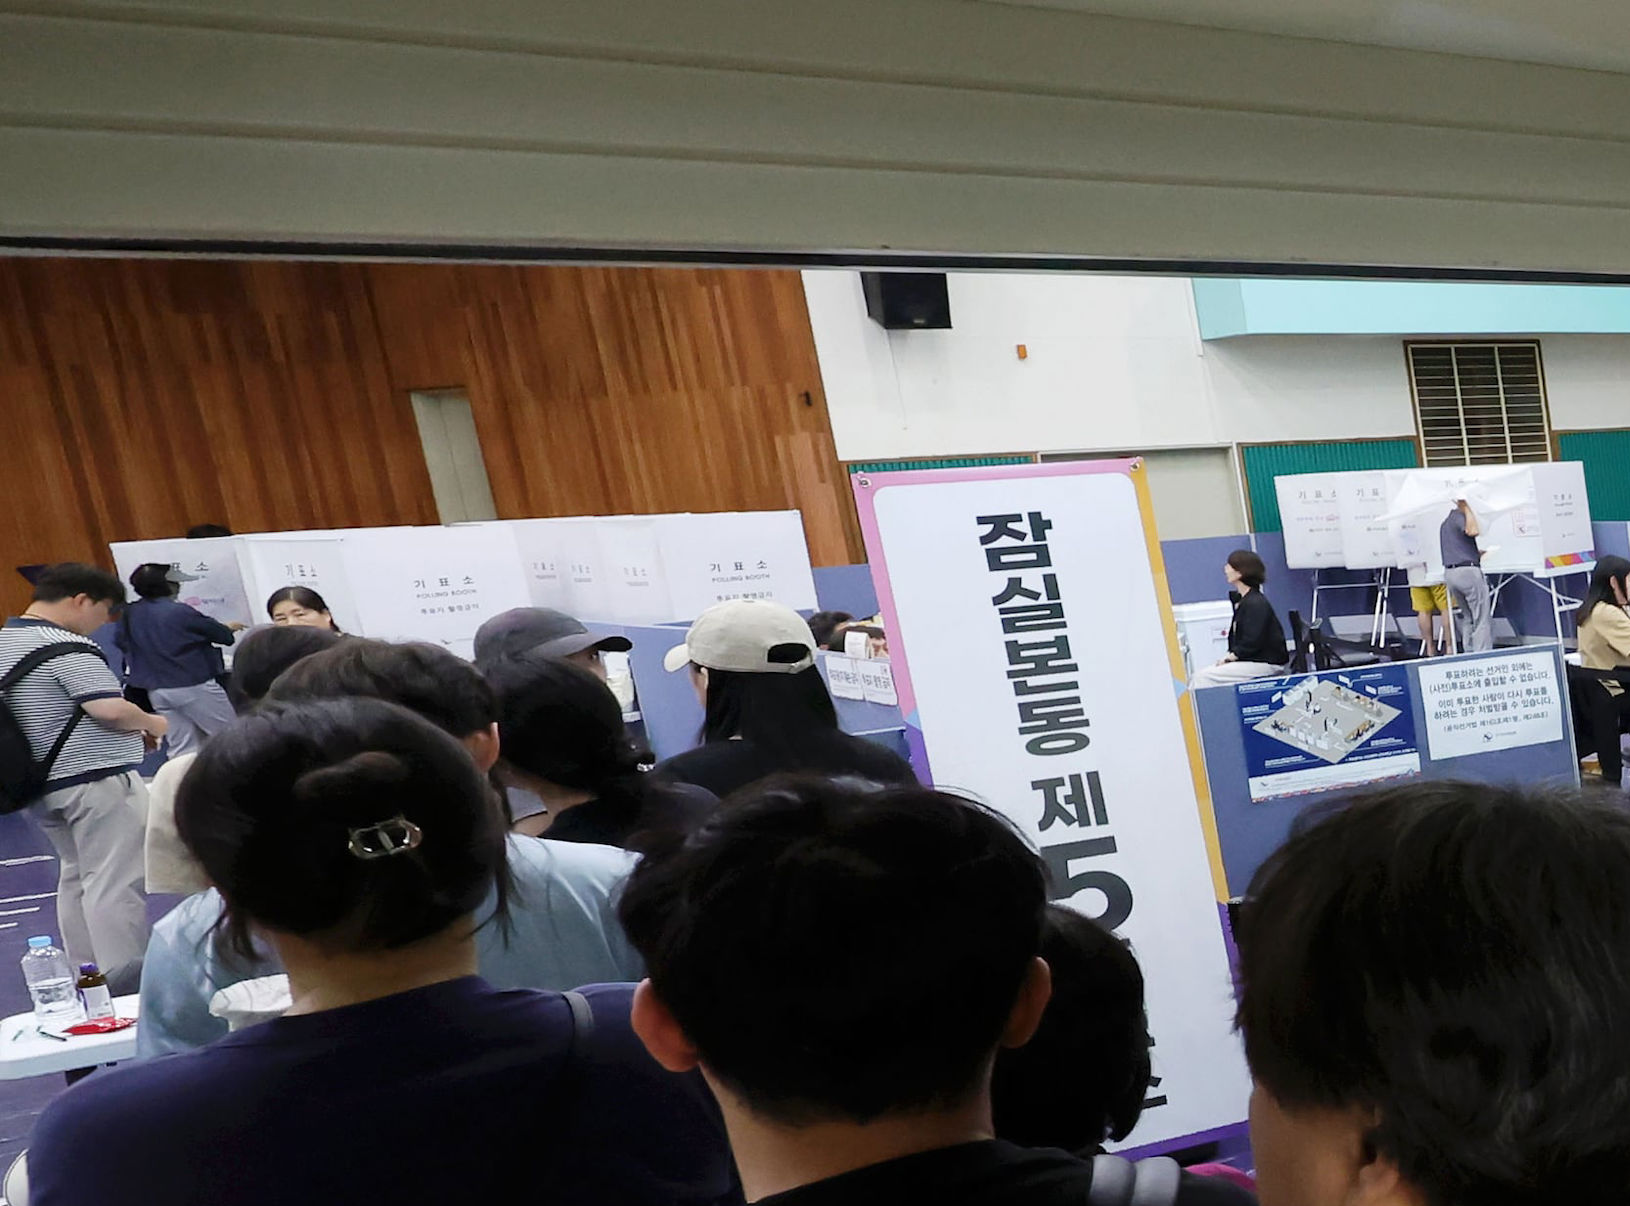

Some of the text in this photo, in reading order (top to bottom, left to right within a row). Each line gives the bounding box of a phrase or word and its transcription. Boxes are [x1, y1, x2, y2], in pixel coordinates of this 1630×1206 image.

[976, 511, 1090, 756] 잠실본동
[1445, 661, 1533, 680] 투표하려는 선거인 외에는
[1429, 671, 1552, 694] (사전)투표소에 출입할 수 없습니다.
[1434, 709, 1458, 720] 하려는
[1461, 707, 1475, 718] 경우
[1510, 701, 1519, 710] 수
[1521, 697, 1555, 709] 있습니다.
[1438, 686, 1548, 709] 이미 투표한 사람이 다시 투표를
